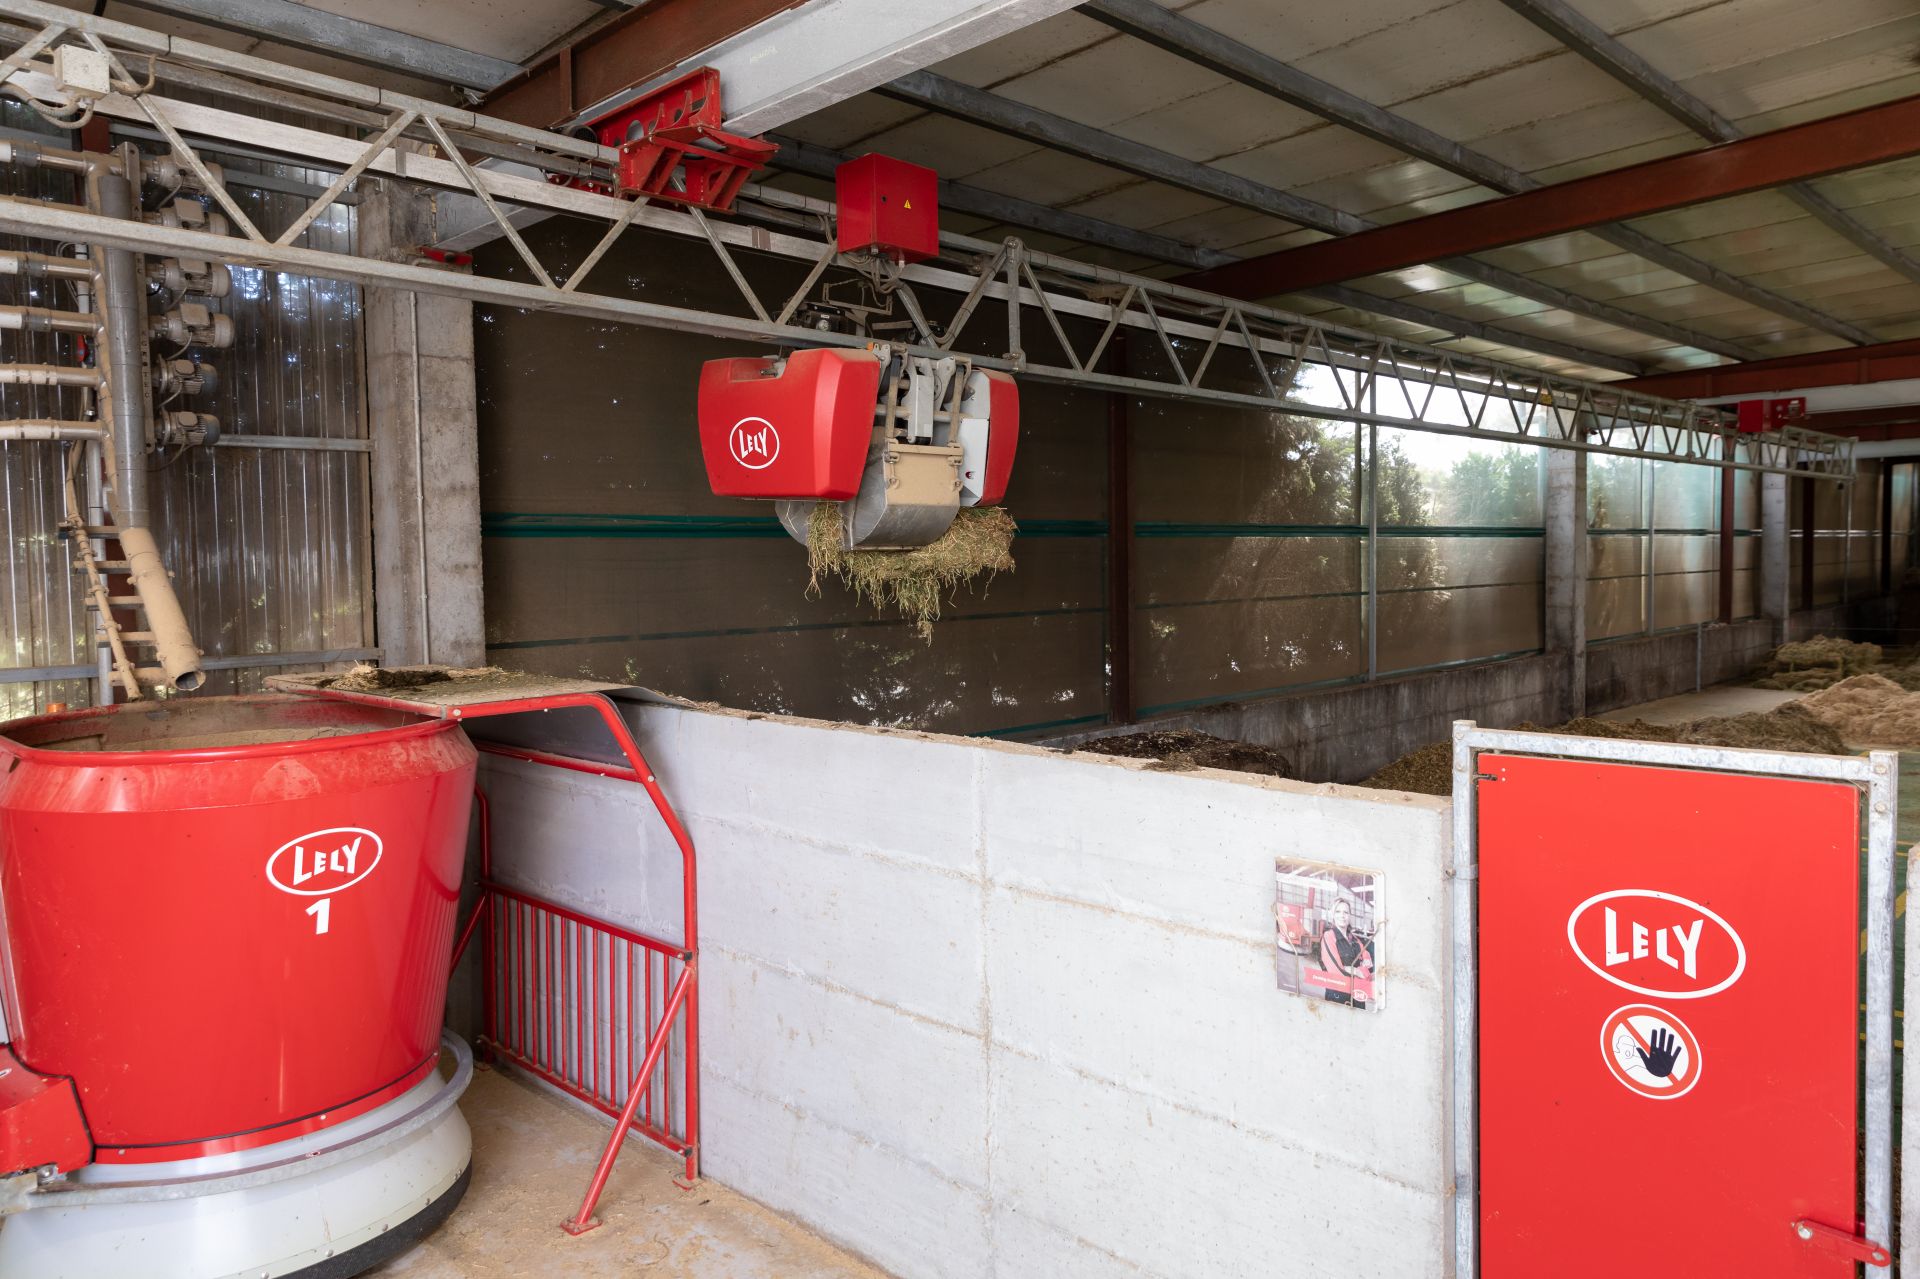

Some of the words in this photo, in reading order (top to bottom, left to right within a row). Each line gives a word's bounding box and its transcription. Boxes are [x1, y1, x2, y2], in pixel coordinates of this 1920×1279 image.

[739, 427, 768, 459] LELY
[293, 836, 362, 886] LELY
[305, 898, 331, 935] 1
[1605, 906, 1704, 980] LELY
